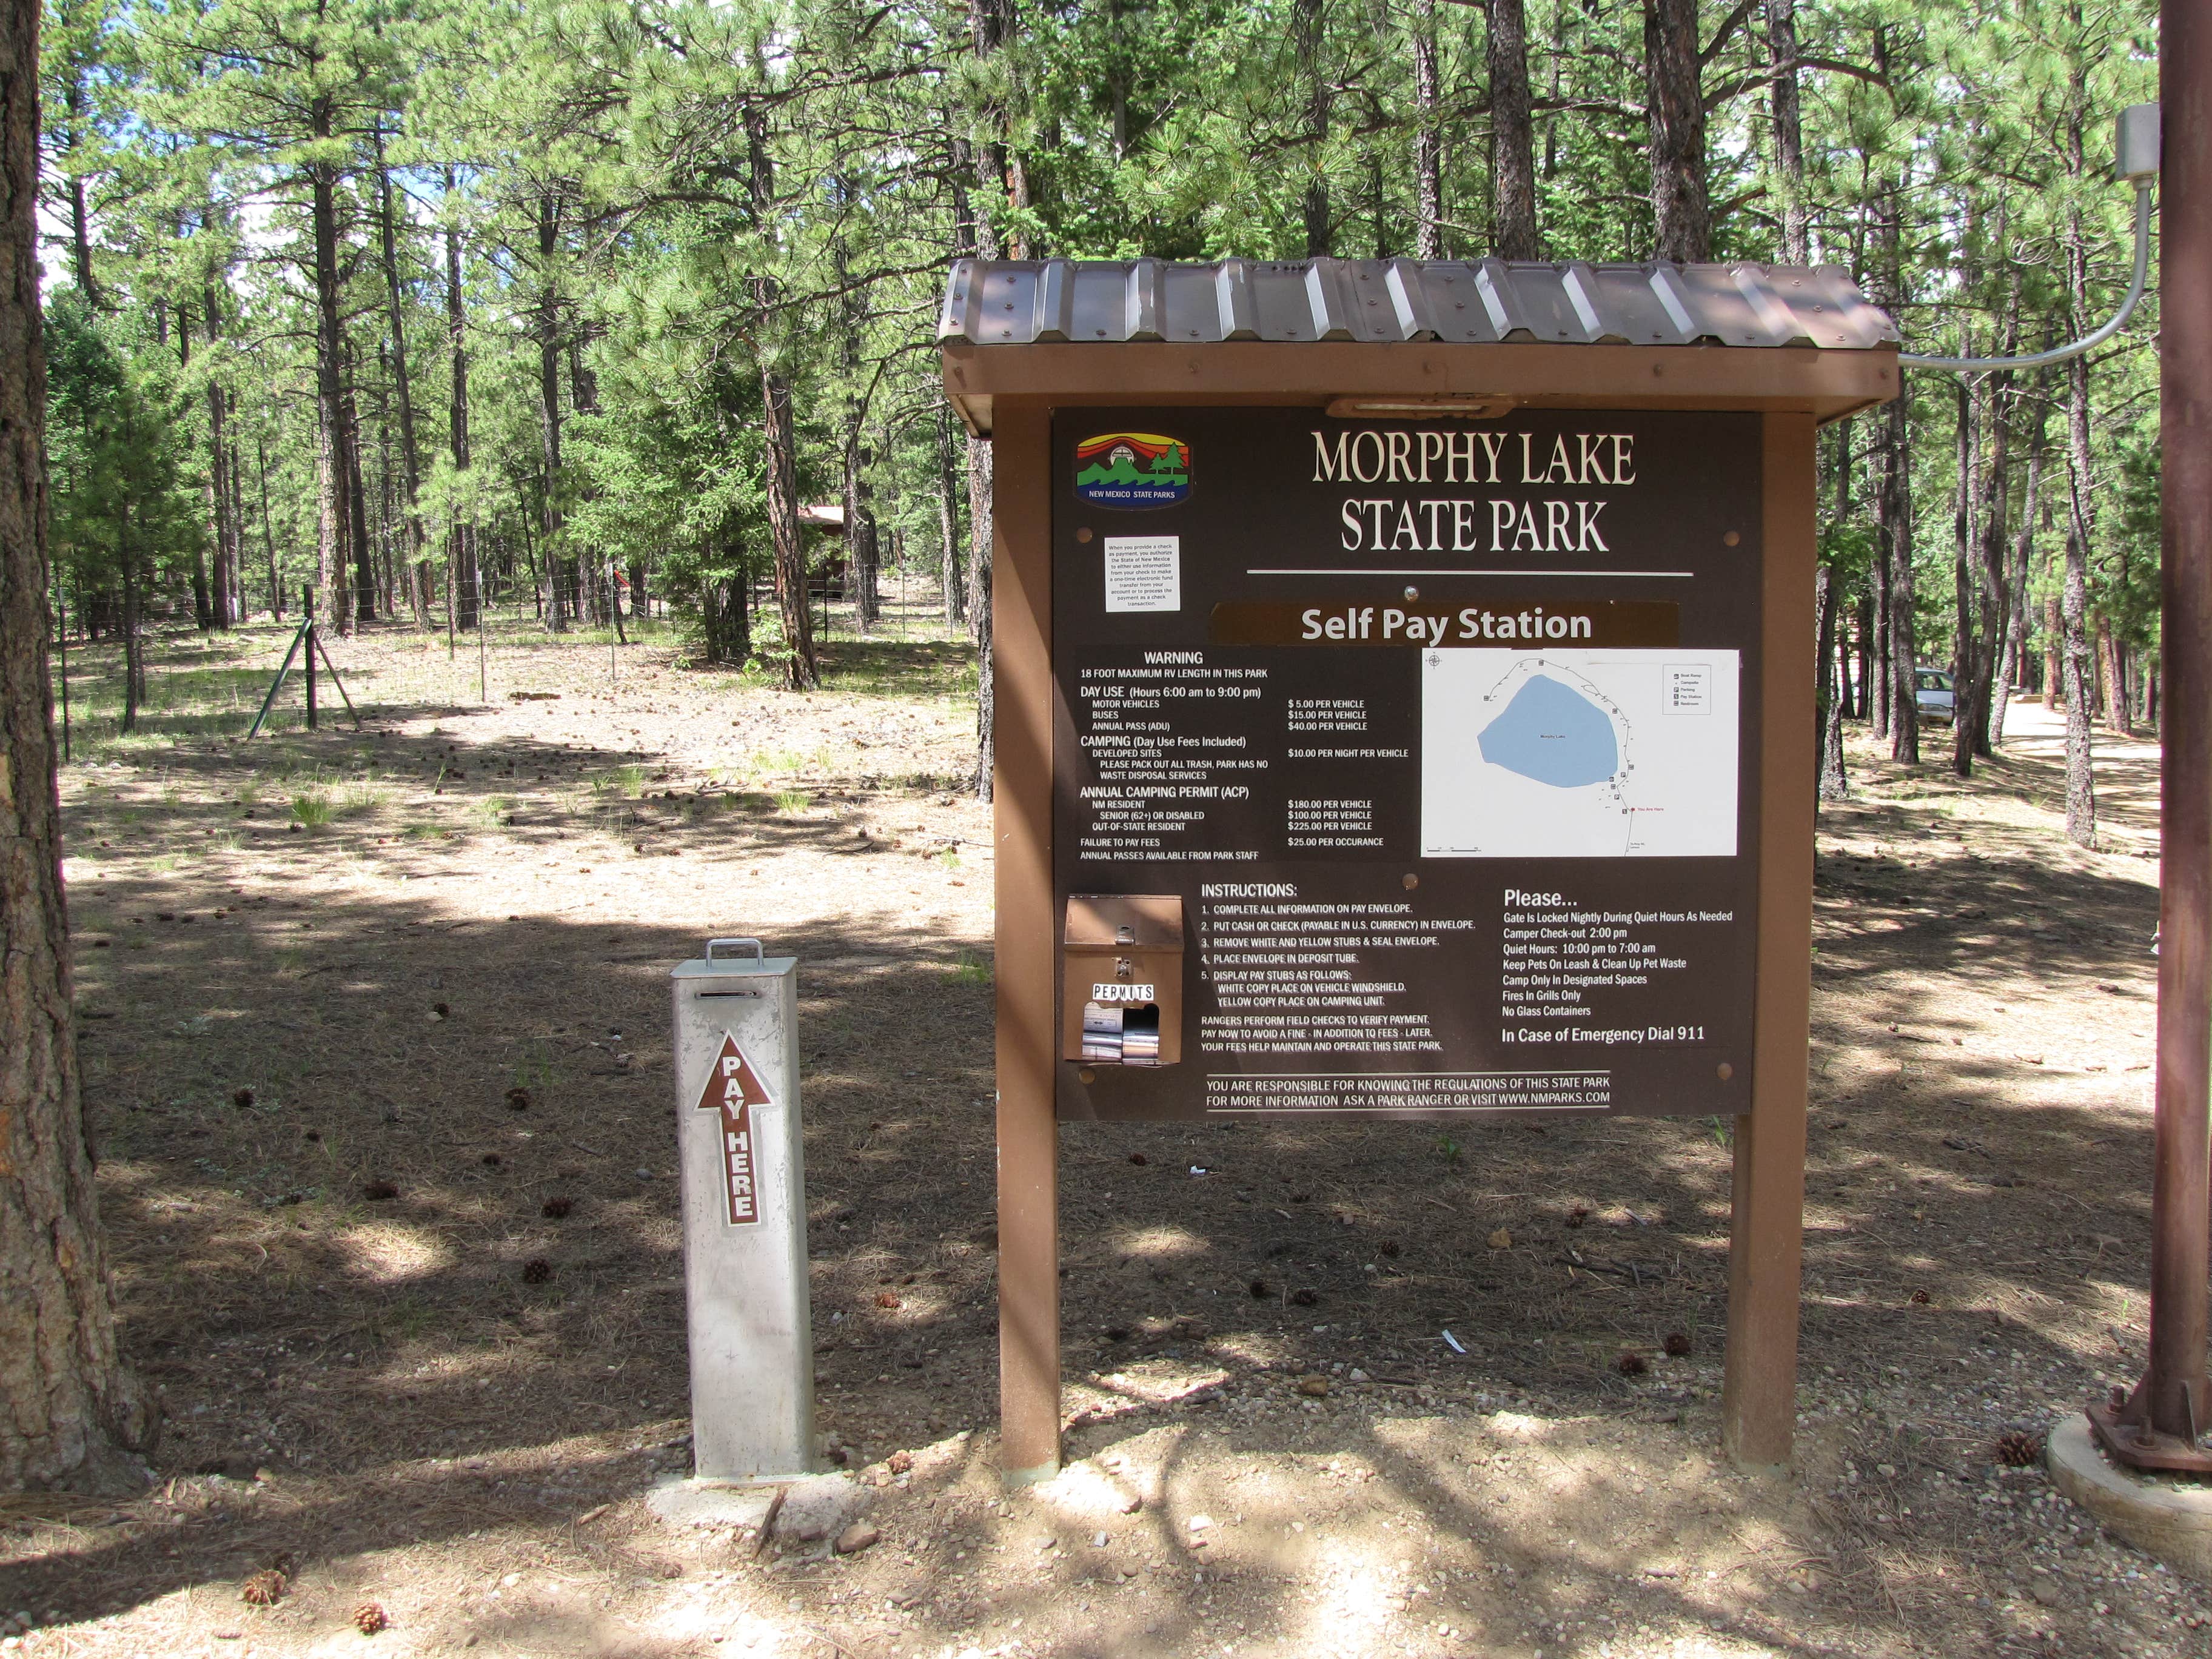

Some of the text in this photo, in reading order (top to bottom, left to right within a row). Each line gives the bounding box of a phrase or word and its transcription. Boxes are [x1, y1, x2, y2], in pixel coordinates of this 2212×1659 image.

[1312, 432, 1635, 484] MORPHY LAKE
[1342, 499, 1609, 551] STATE PARK
[1302, 608, 1590, 647] Self Pay Station
[1145, 652, 1202, 664] WARNING
[1118, 669, 1162, 677] MAXIMUM
[1178, 669, 1210, 677] LENGTH
[1081, 686, 1101, 697] DAY
[1104, 686, 1124, 697] USE
[1130, 687, 1161, 699] (Hours
[1164, 687, 1185, 697] 6:00
[1206, 688, 1215, 697] to
[1218, 687, 1240, 697] 9:00
[1244, 688, 1261, 699] pm)
[1289, 710, 1316, 719] $15.00
[1148, 722, 1170, 731] (ADU)
[1081, 736, 1245, 748] CAMPING (Day Use Fees Included)
[1289, 749, 1316, 757] $10.00
[1080, 786, 1248, 799] ANNUAL CAMPING PERMIT (ACP)
[1288, 800, 1321, 808] $180.00
[1131, 811, 1151, 821] (62+)
[1166, 811, 1204, 820] DISABLED
[1288, 837, 1316, 846] $25.00
[1504, 911, 1732, 924] Gate Is Locked Nightly During Quiet Hours As Needed
[1504, 928, 1627, 940] Camper Check-out 2:00 pm
[1504, 944, 1527, 956] Quiet
[1563, 943, 1589, 953] 10:00
[1592, 946, 1605, 955] pm
[1608, 944, 1617, 953] to
[1620, 943, 1640, 953] 7:00
[1214, 954, 1241, 964] PLACE
[1242, 954, 1286, 964] ENVELOPE
[1287, 954, 1296, 964] IN
[1298, 954, 1334, 964] DEPOSIT
[1094, 985, 1152, 999] PERMITS
[1503, 990, 1581, 1002] Fires In Grills Only
[1503, 1006, 1590, 1016] No Glass Containers
[1503, 1027, 1704, 1044] In Case of Emergency Dial 911
[722, 1056, 745, 1119] PAY
[1207, 1078, 1610, 1092] YOU ARE RESPONSIBLE FOR KNOWING THE REGULATIONS OF THIS STATE PARK
[1207, 1092, 1610, 1107] FOR MORE INFORMATION ASK A PARK RANGER OR VISIT WWW.NMPARKS.COM
[728, 1131, 752, 1216] HERE
